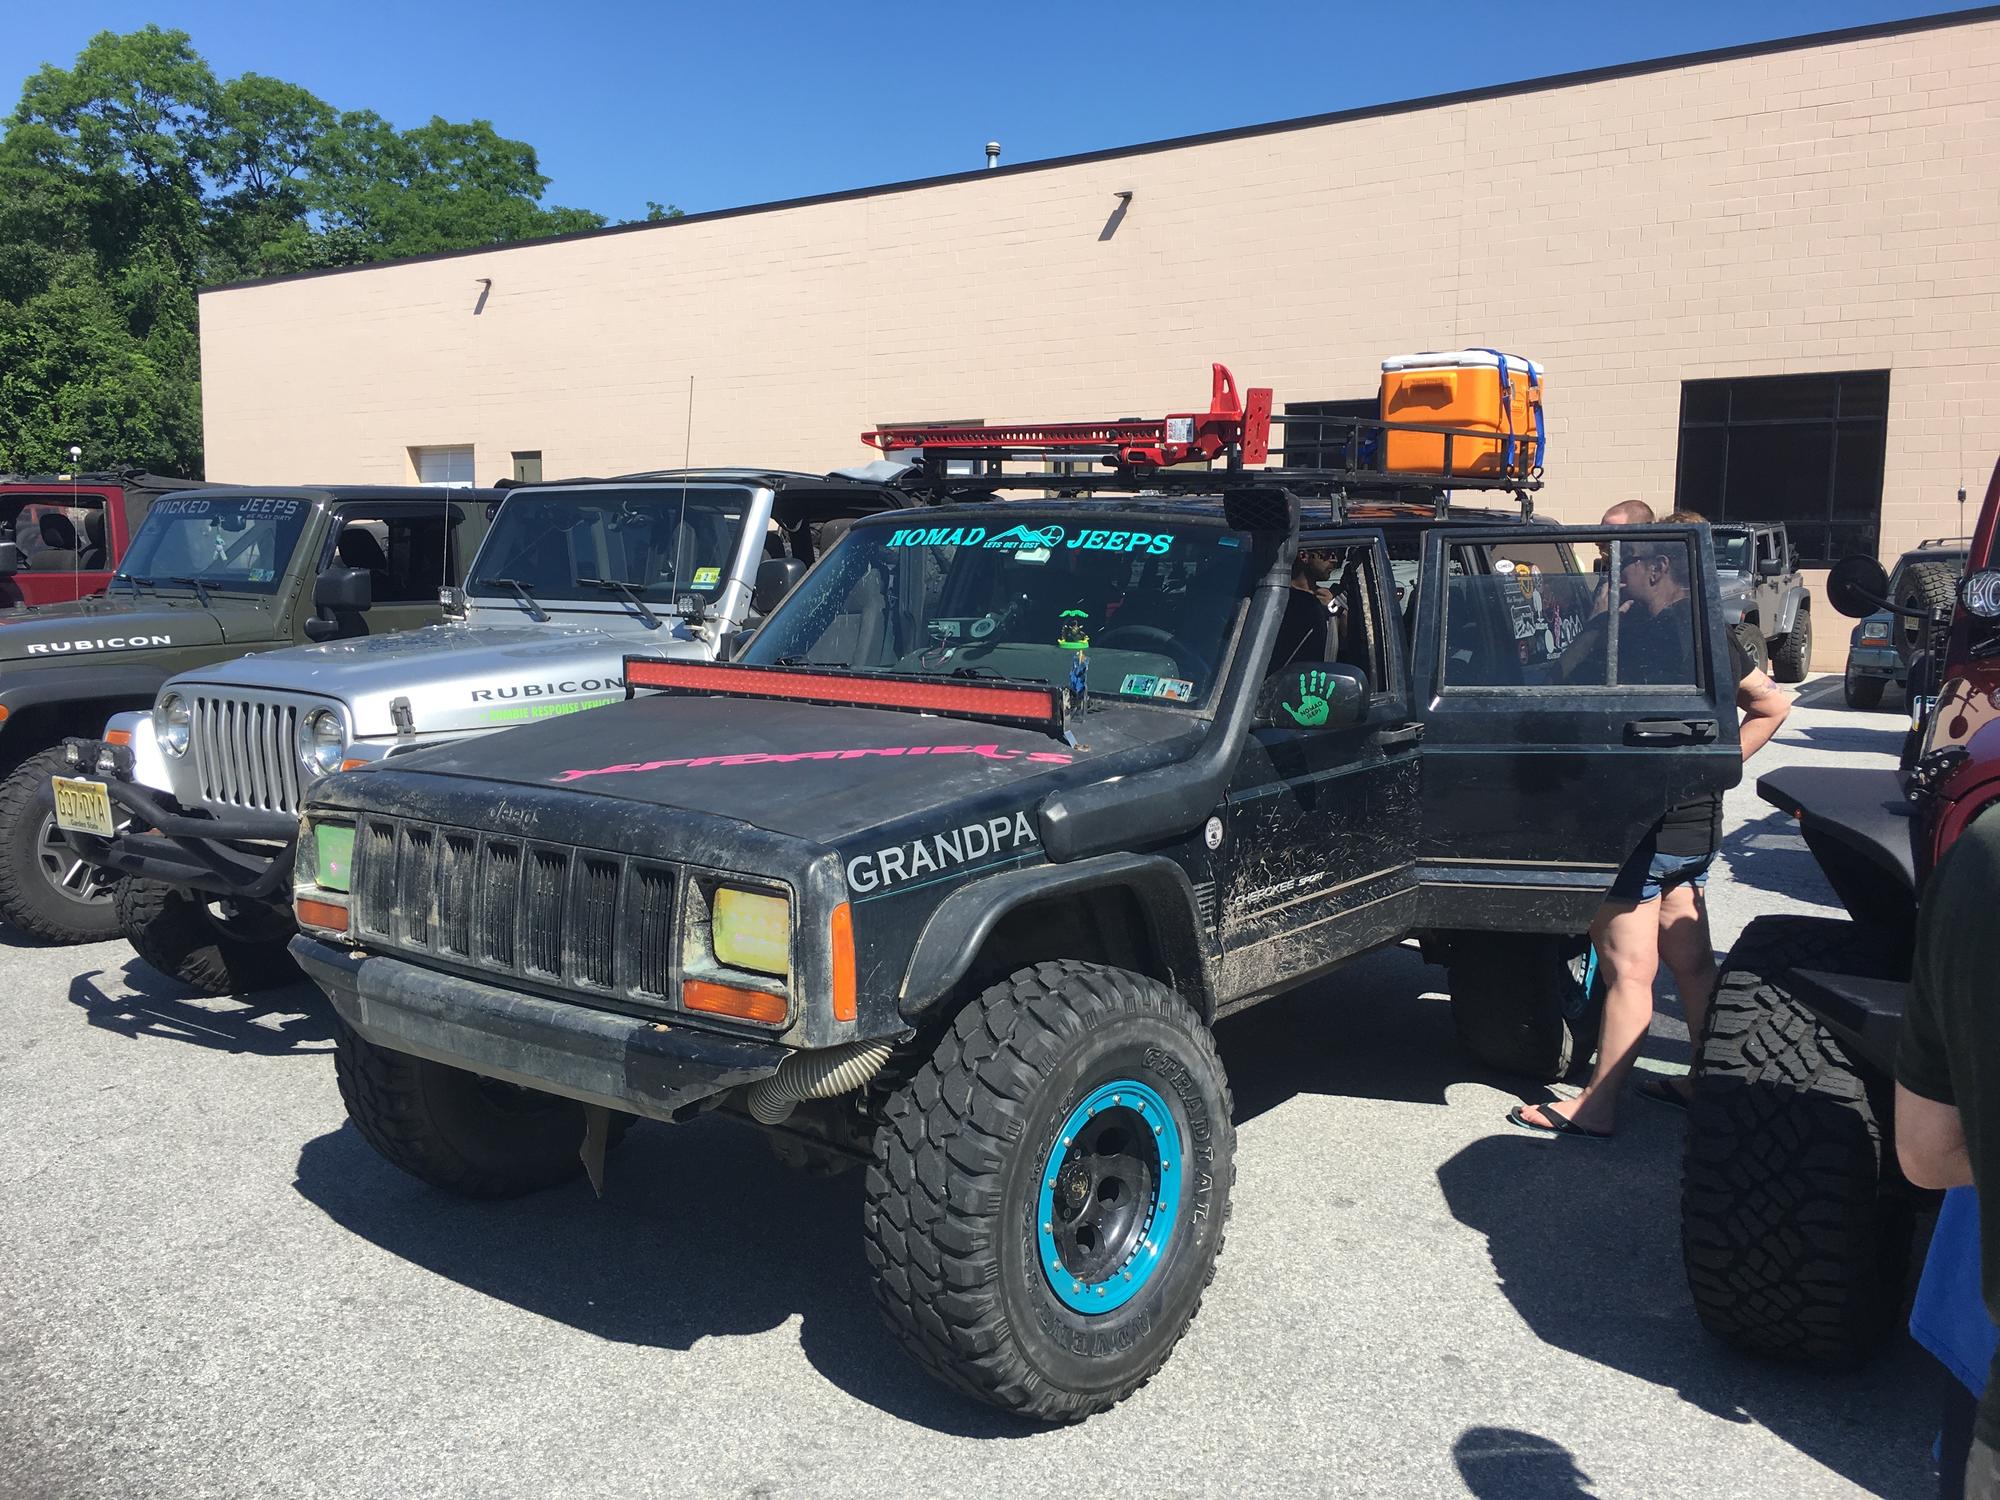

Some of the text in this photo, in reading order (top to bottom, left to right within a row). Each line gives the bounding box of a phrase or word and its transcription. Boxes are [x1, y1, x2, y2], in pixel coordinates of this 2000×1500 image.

[154, 498, 299, 515] WICKED JEEPS
[886, 527, 1175, 555] NOMAD JEEPS
[983, 541, 1002, 549] LETS
[1019, 541, 1040, 549] LOST
[26, 635, 171, 654] RUBICON
[471, 677, 624, 702] RUBICON
[531, 702, 579, 718] RESPONSE
[847, 810, 1038, 893] GRANDPA
[1235, 871, 1326, 906] CHEROKEE SPORT
